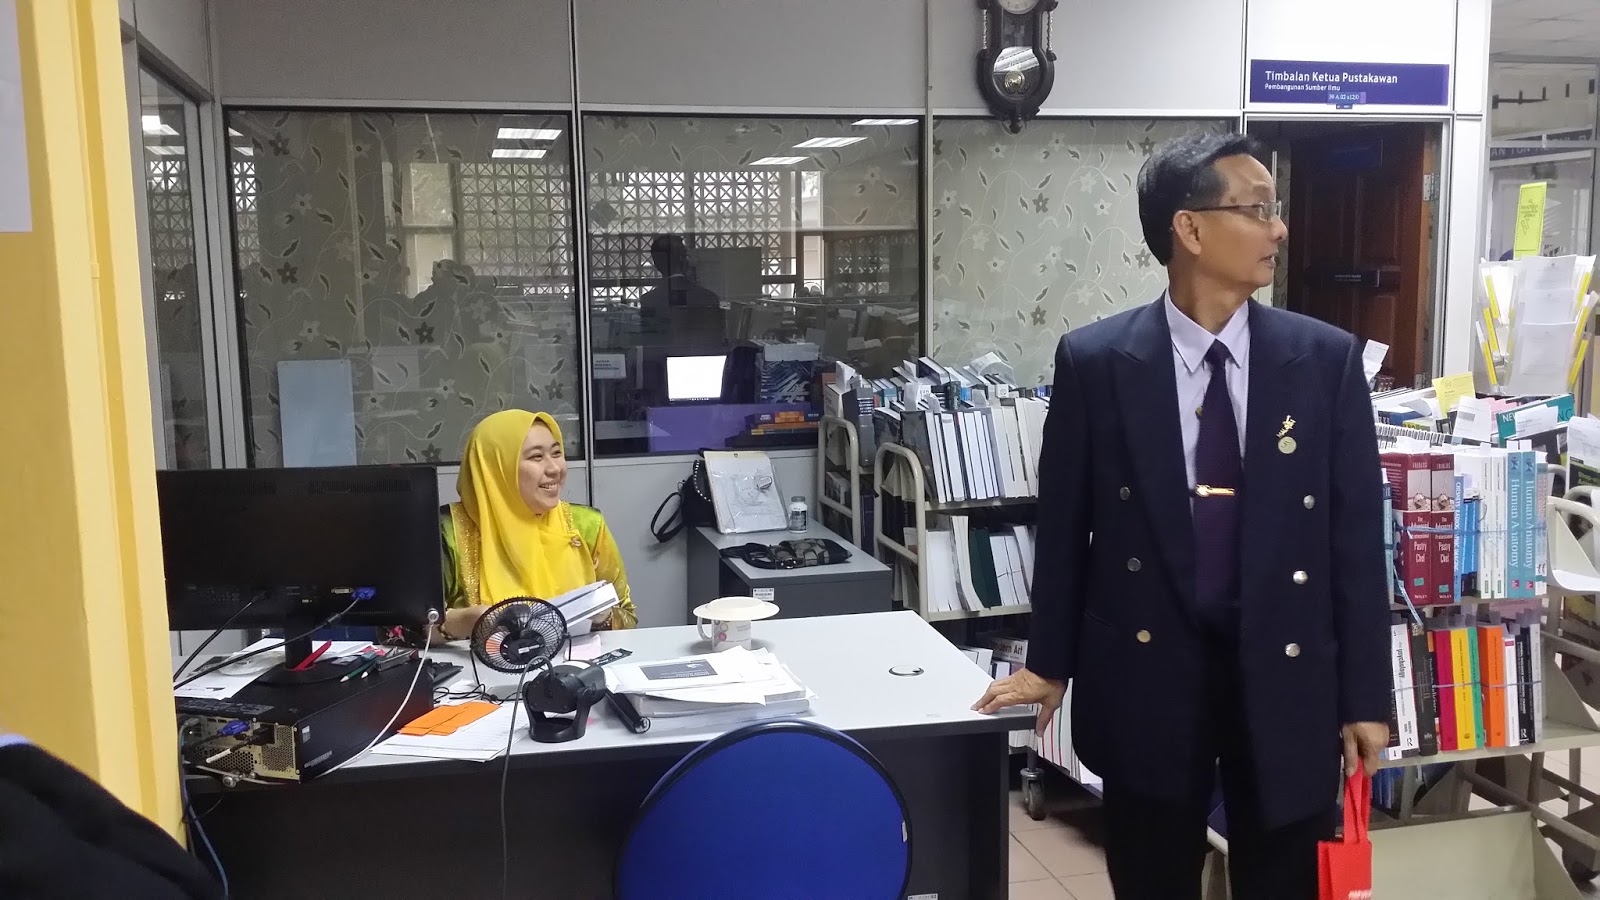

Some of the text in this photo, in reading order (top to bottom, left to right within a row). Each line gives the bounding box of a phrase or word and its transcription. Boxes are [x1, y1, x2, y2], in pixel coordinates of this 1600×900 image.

[1265, 70, 1398, 84] Timbalan Ketua Pustakawan
[1264, 82, 1305, 92] Pembangunan
[1305, 83, 1327, 91] Sumber
[1511, 479, 1520, 519] Human
[1523, 480, 1534, 569] Human Anatomy
[1413, 541, 1427, 553] Pastry
[1438, 541, 1451, 553] Pastry
[1415, 553, 1425, 563] Chef
[1440, 554, 1450, 564] Chef
[1396, 648, 1407, 678] psychology
